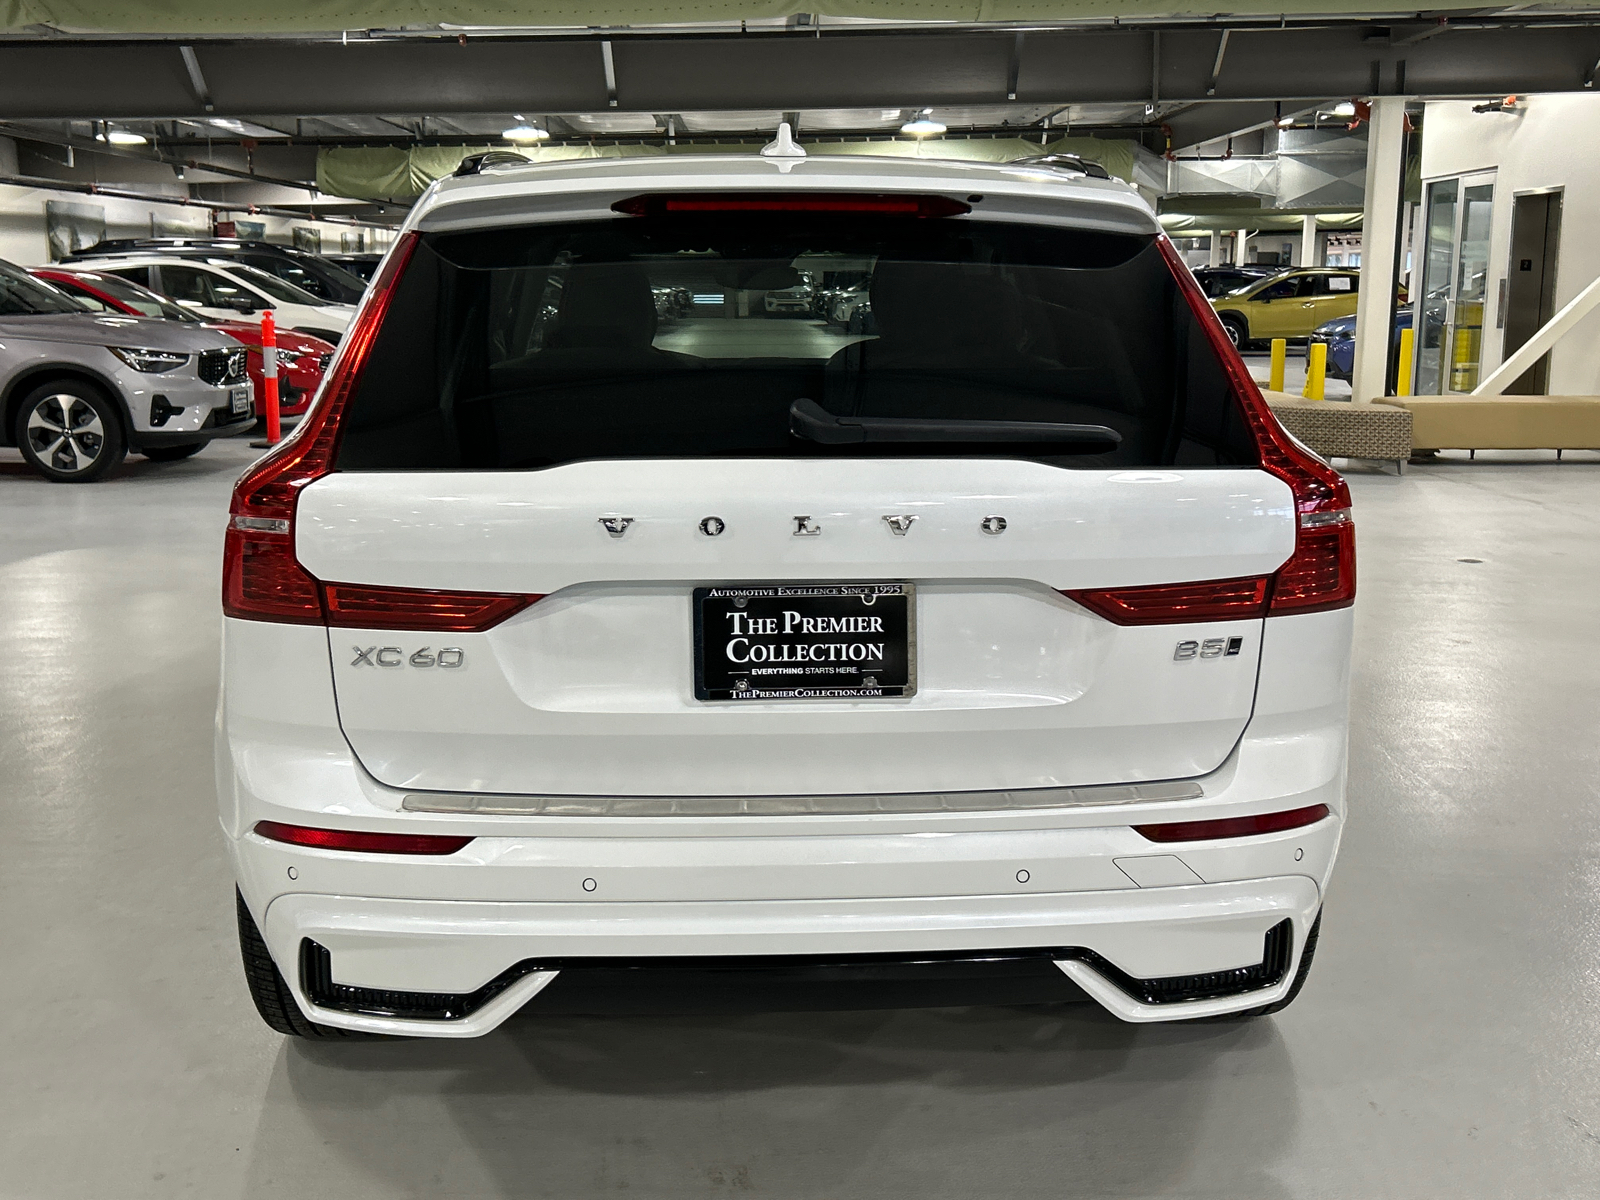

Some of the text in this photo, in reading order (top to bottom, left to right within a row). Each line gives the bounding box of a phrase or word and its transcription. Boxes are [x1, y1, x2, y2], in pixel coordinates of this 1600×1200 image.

[597, 515, 1008, 538] VOLVO
[709, 585, 901, 597] AUTOMOTIVE EXCELLENCE SINCE 1995
[726, 610, 885, 635] THE PREMIER
[350, 646, 465, 669] XC60
[726, 637, 885, 663] COLLECTION
[1173, 637, 1225, 661] B5
[751, 666, 860, 675] EVERYTHING STARTS HERE.
[729, 688, 883, 699] THEPREMIERCOLLECTION.COM
